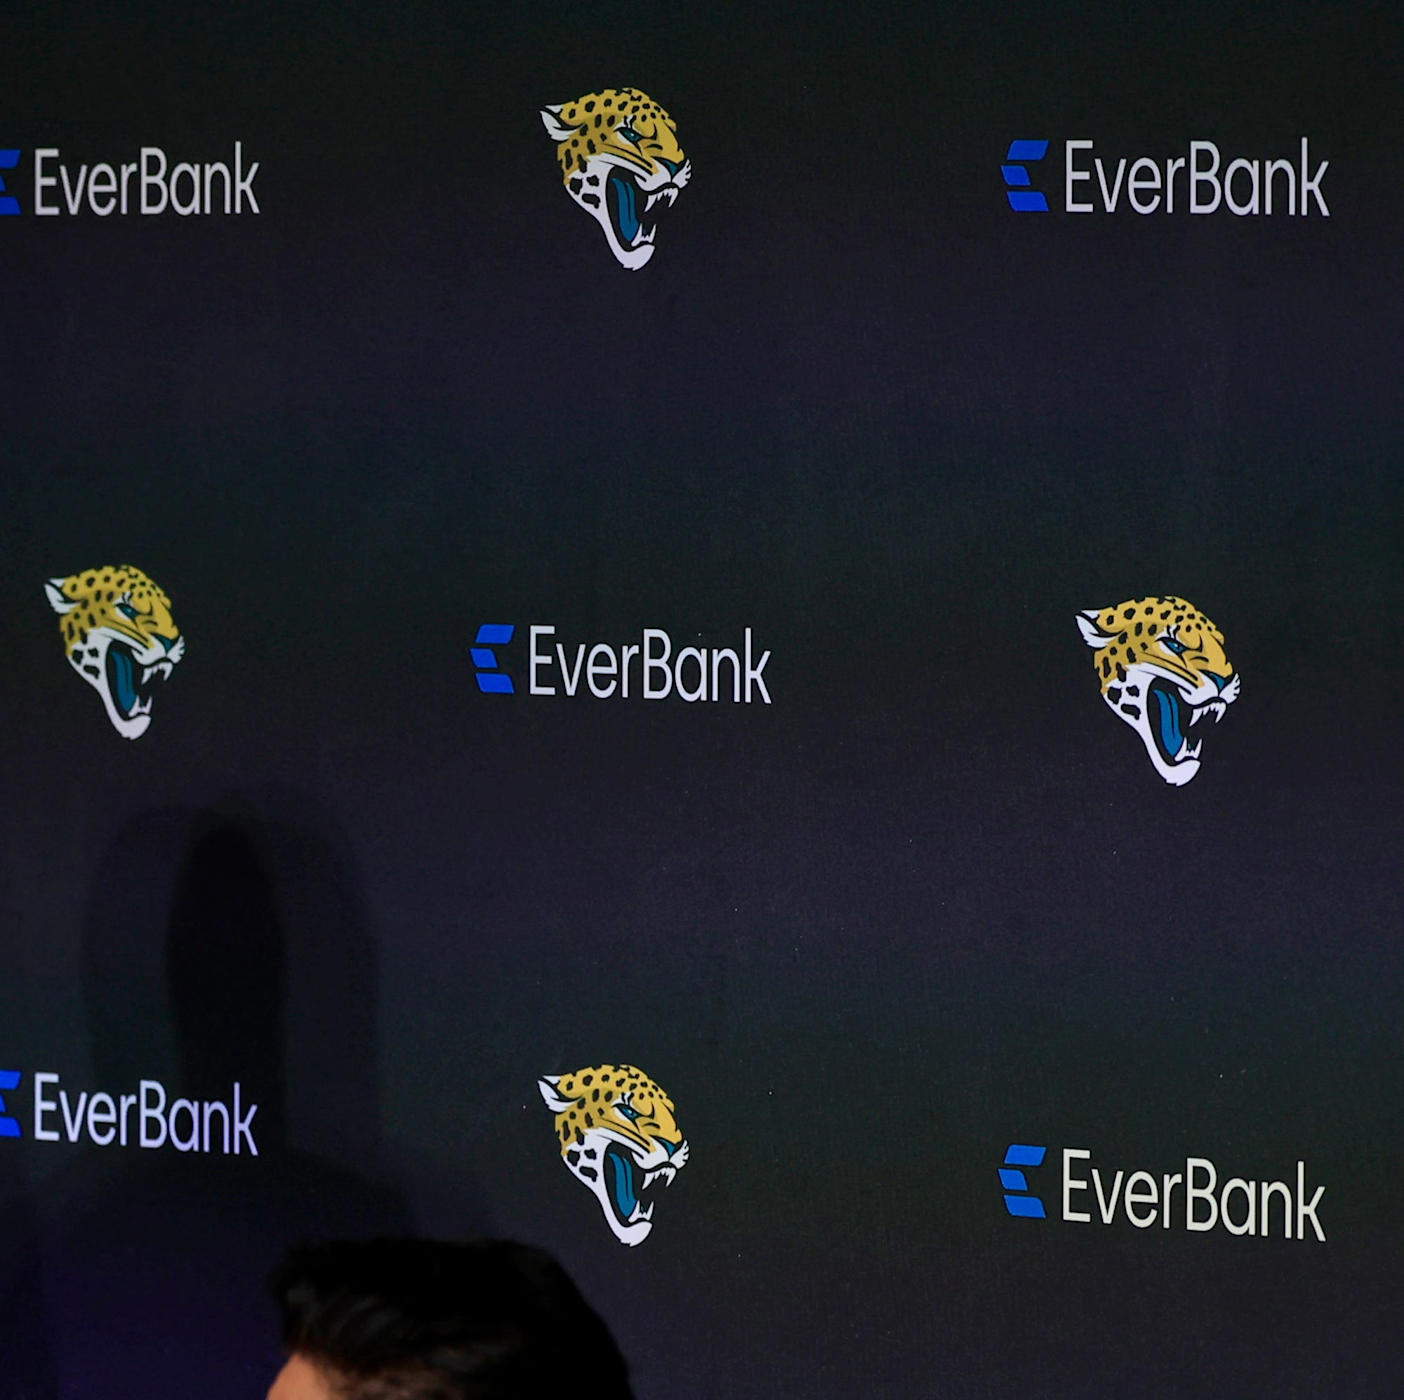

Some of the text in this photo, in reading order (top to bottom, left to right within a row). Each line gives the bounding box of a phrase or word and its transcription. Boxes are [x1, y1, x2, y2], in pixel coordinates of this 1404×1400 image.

[34, 140, 260, 216] EverBank
[1065, 136, 1330, 217] EverBank
[529, 625, 772, 704] EverBank
[34, 1072, 258, 1156] EverBank
[1062, 1148, 1326, 1242] EverBank
